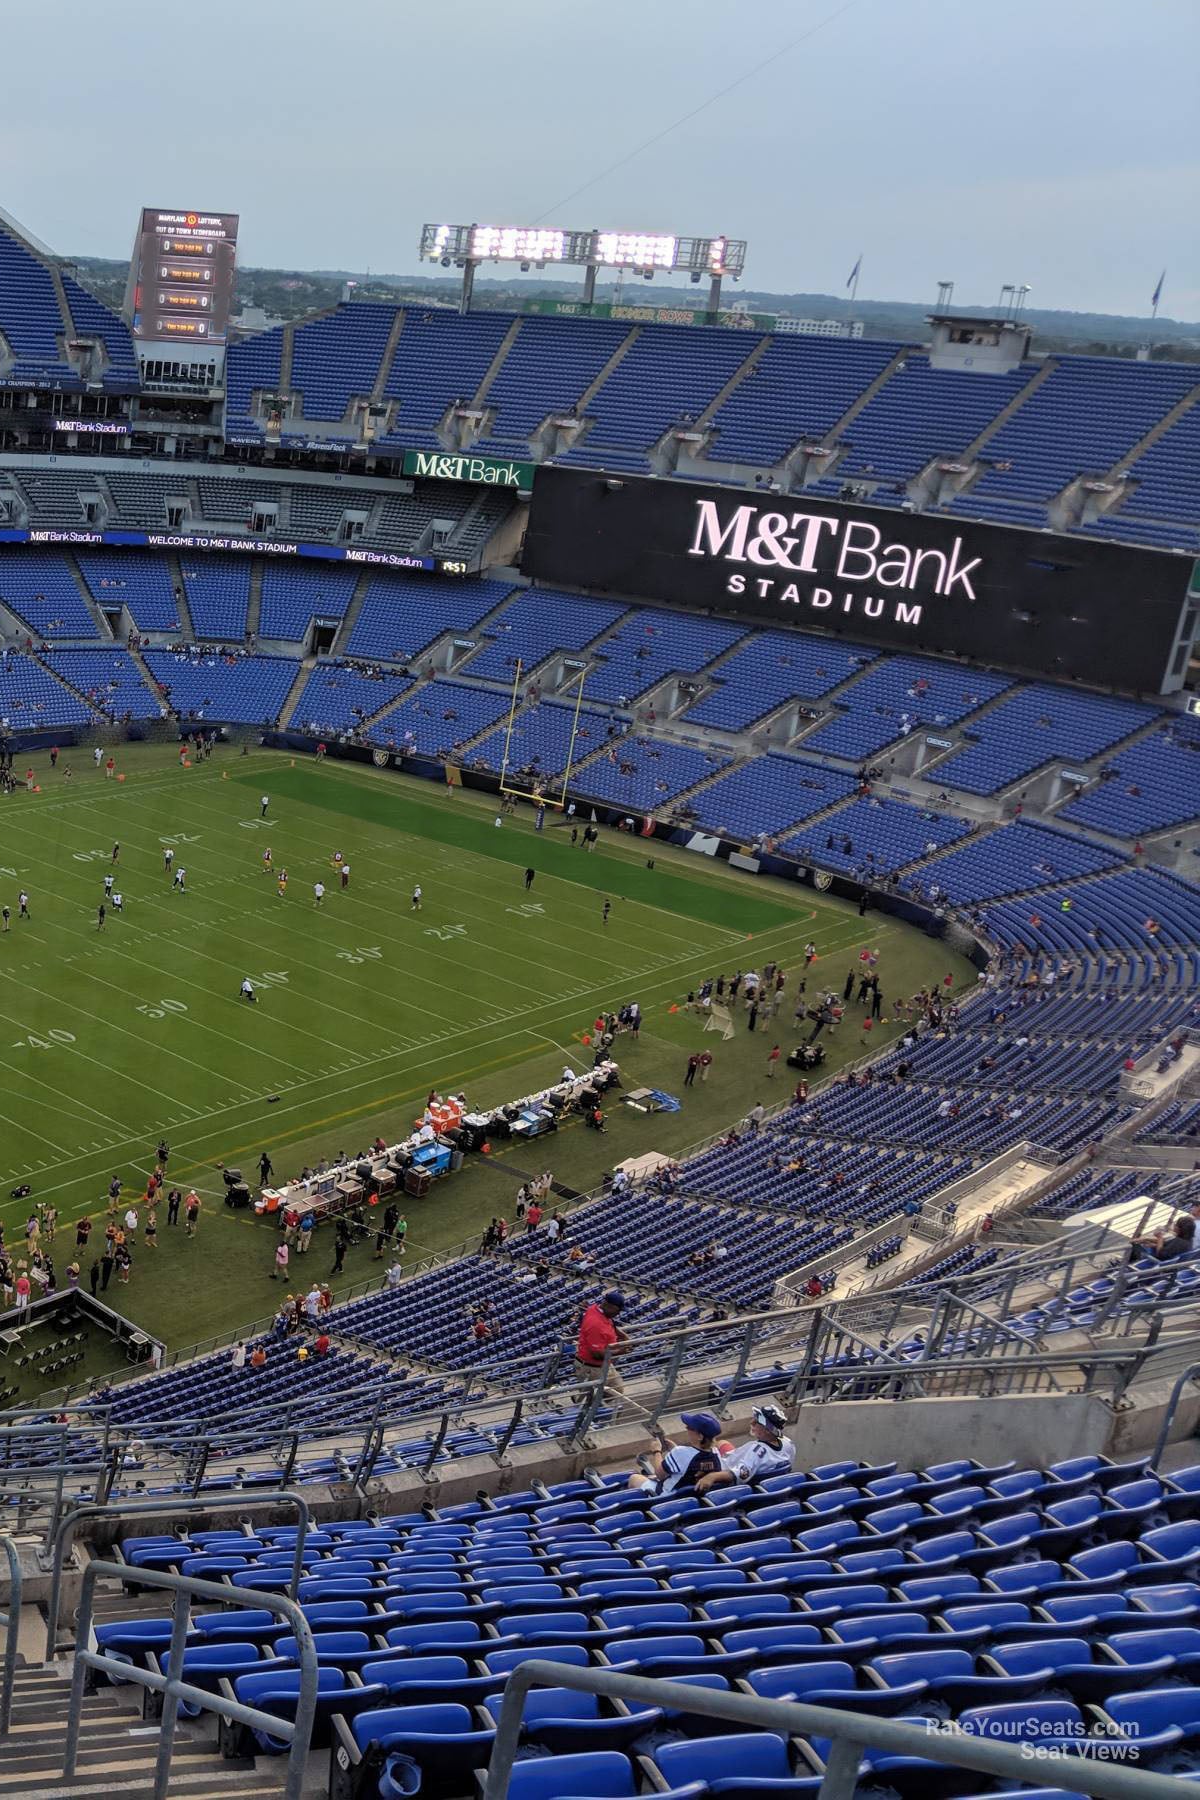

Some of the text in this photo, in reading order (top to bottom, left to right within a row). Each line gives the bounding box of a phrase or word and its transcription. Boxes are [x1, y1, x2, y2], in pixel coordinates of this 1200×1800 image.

[164, 241, 169, 250] 0
[207, 244, 212, 253] 0
[162, 268, 167, 277] 0
[205, 271, 210, 280] 0
[160, 294, 164, 303] 0
[202, 297, 207, 306] 0
[158, 321, 162, 330] 0
[199, 324, 204, 333] 0
[56, 421, 126, 433] M&T Bank Stadium
[415, 453, 520, 485] M&T Bank
[31, 532, 102, 542] M&T Bank Stadium
[149, 536, 297, 552] WELCOME TO M&T BANK STADIUM
[689, 500, 982, 599] M&T Bank
[346, 550, 422, 567] M&T Bank Stadium
[728, 575, 922, 624] STADIUM
[159, 833, 197, 845] 20
[505, 904, 545, 917] 10
[424, 925, 468, 940] 20
[337, 947, 383, 963] 30
[248, 972, 289, 989] 40
[136, 999, 188, 1018] 50
[27, 1029, 75, 1049] 40
[753, 1444, 766, 1458] 13
